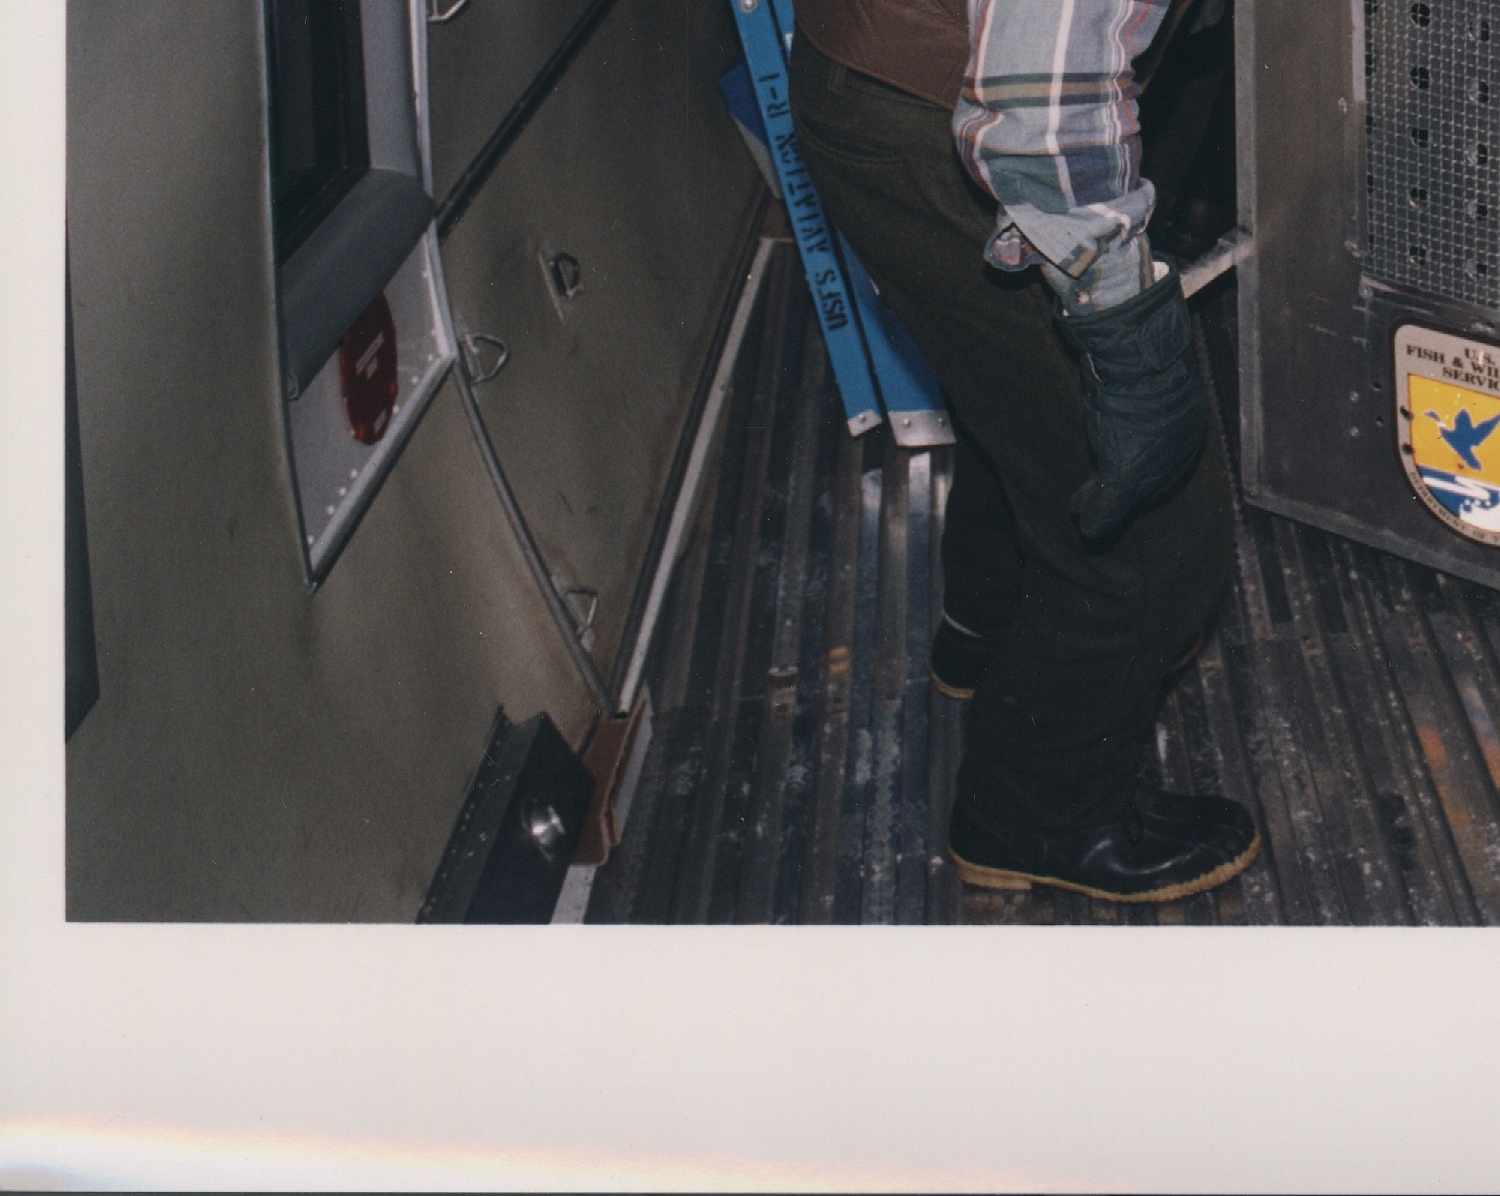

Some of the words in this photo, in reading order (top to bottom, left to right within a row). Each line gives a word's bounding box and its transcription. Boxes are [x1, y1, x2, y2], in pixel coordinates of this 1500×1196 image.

[815, 268, 848, 331] USFS
[1406, 344, 1446, 364] FISH
[1452, 356, 1464, 368] &
